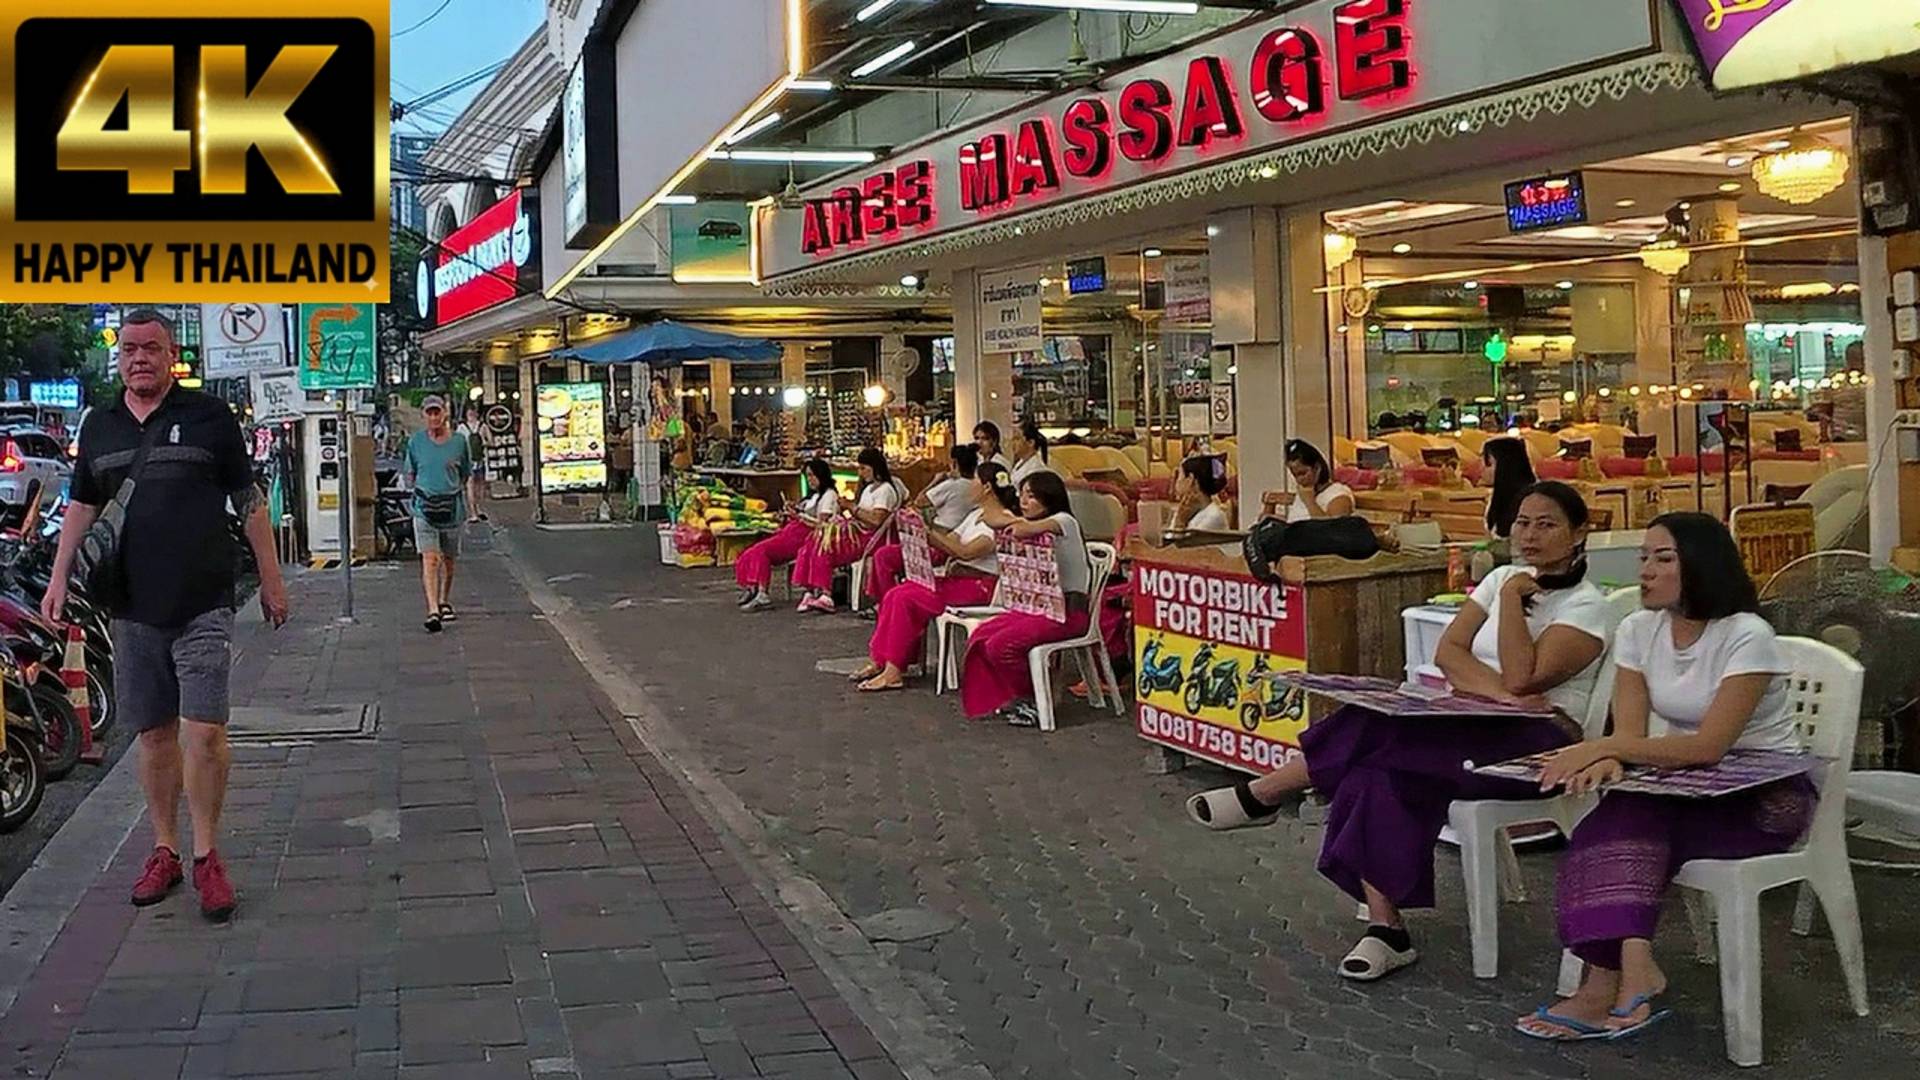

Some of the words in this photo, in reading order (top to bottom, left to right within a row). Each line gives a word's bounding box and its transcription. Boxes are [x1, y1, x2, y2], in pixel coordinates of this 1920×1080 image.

[802, 160, 932, 254] AREE
[959, 0, 1410, 210] MASSAGE
[1175, 380, 1210, 398] OPEN
[1139, 567, 1288, 619] MOTORBIKE
[1155, 600, 1201, 636] FOR
[1207, 609, 1276, 650] RENT
[1159, 717, 1195, 744] 081
[1199, 723, 1236, 757] 758
